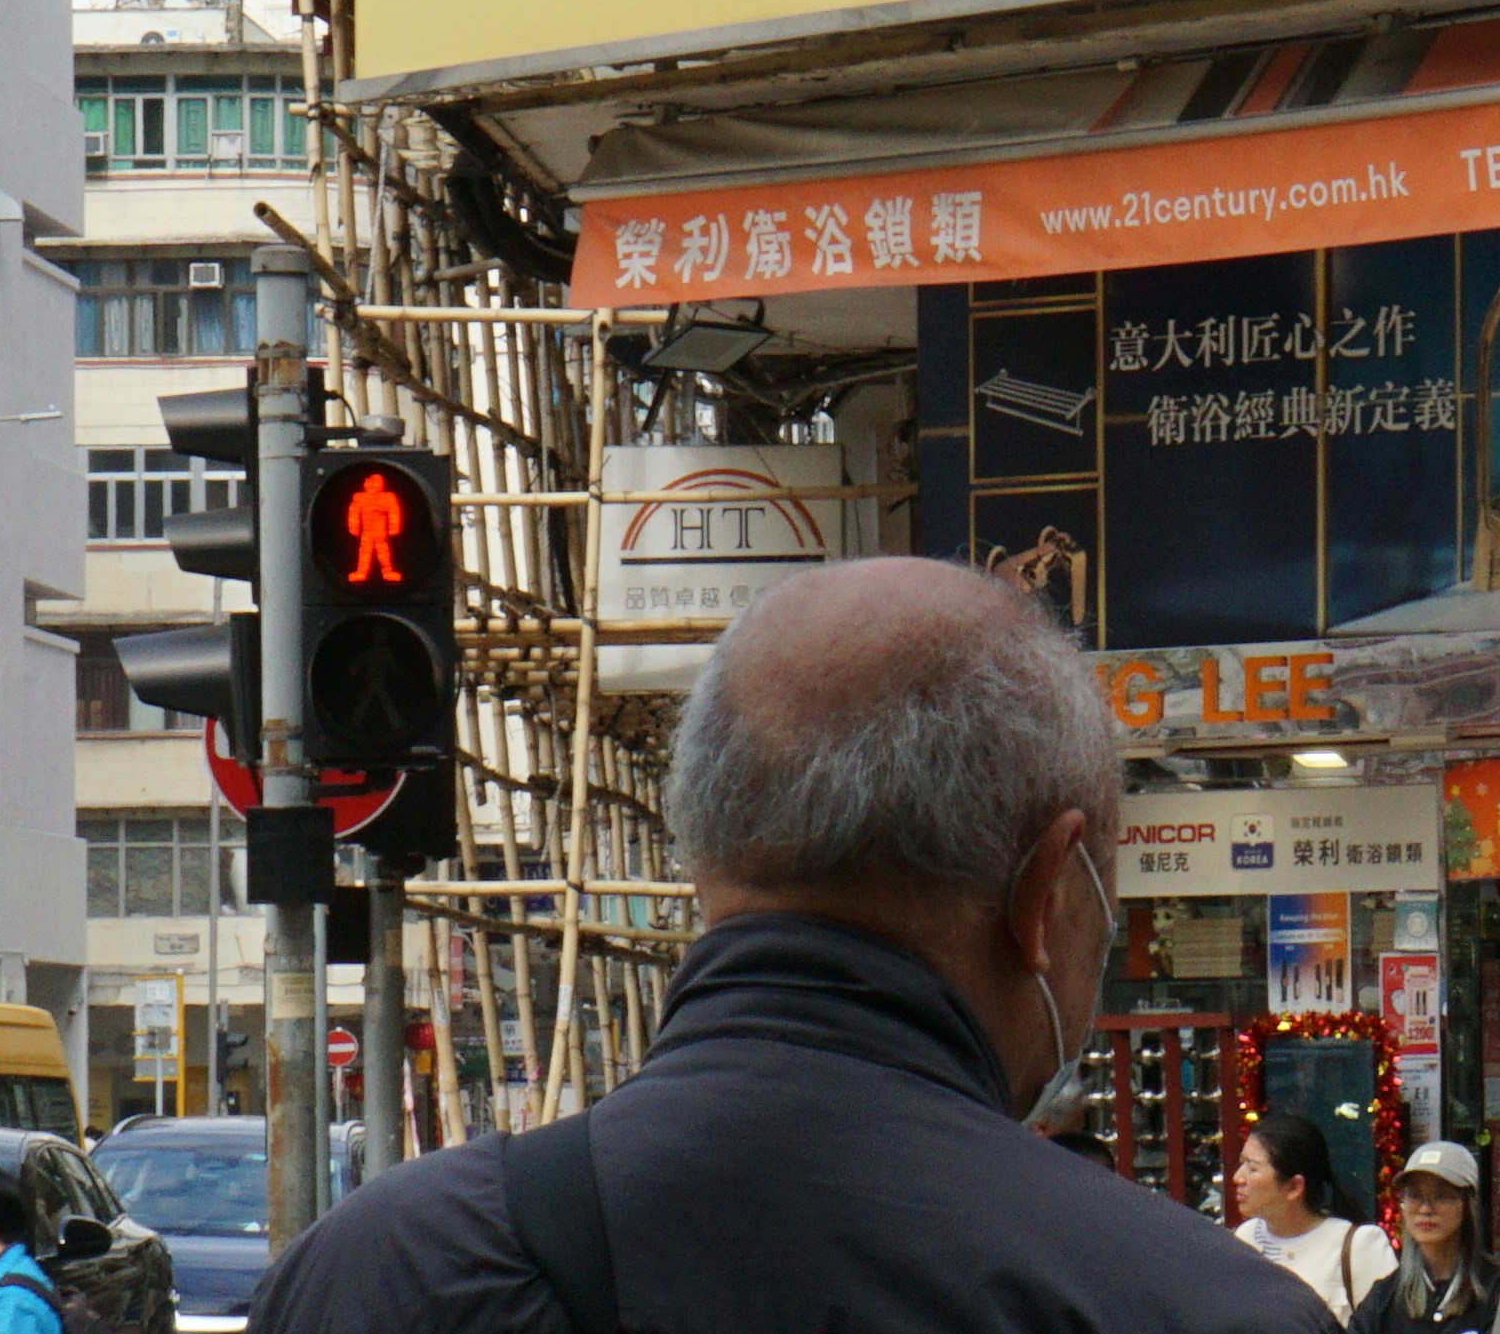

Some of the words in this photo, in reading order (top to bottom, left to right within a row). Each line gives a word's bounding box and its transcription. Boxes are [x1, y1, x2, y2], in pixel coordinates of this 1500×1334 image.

[1040, 160, 1411, 237] www.21century.com.hk
[1108, 304, 1418, 373] 意大利匠心之作
[670, 507, 766, 550] HT
[1201, 653, 1334, 723] LEE
